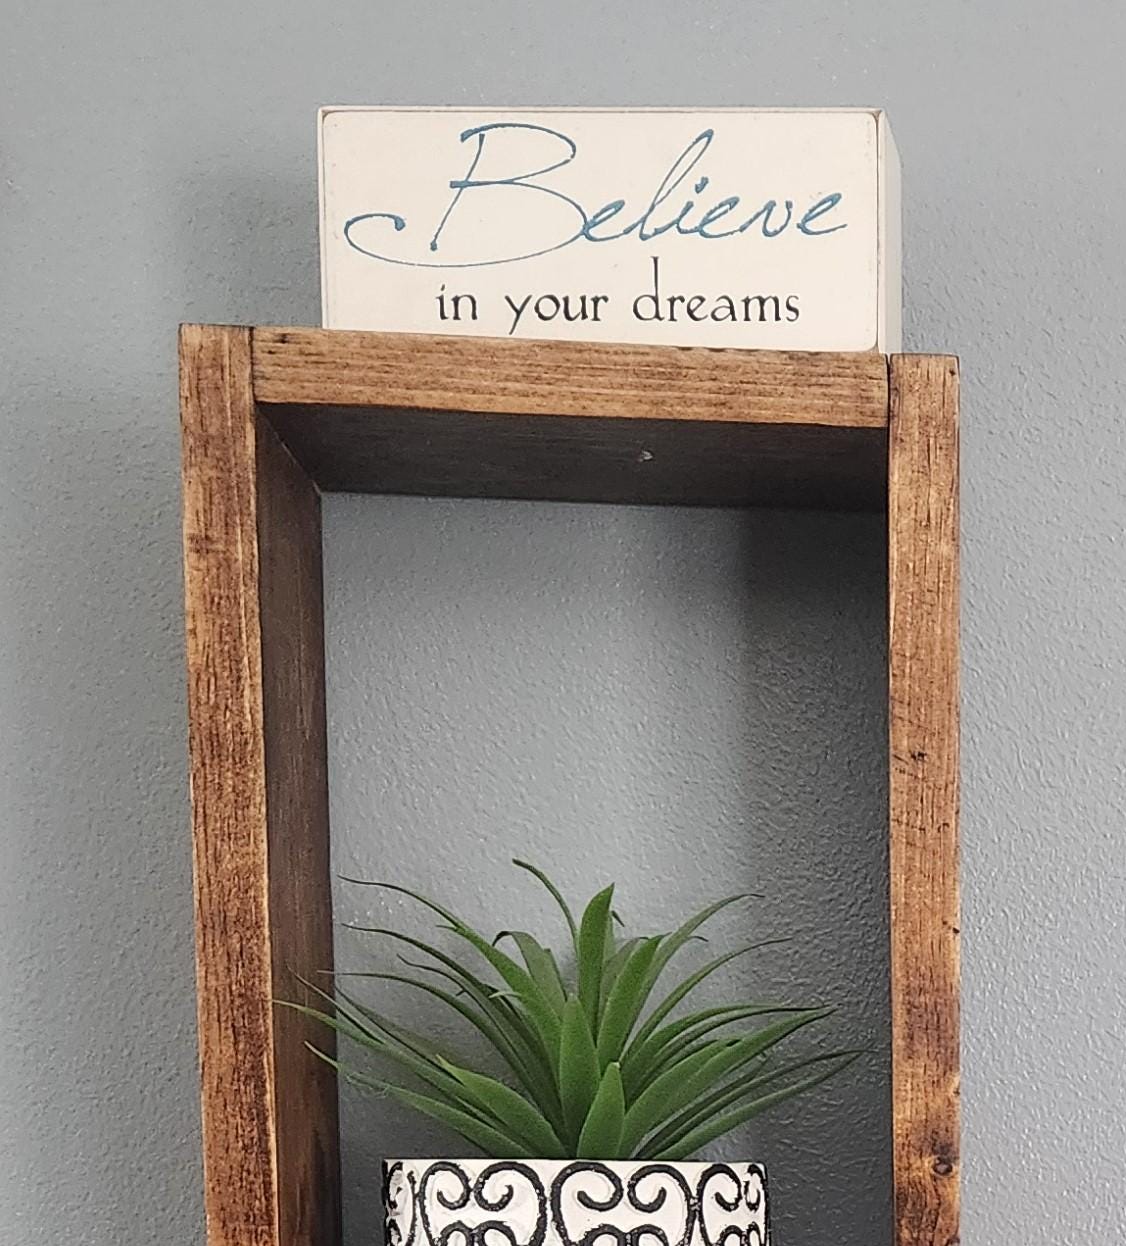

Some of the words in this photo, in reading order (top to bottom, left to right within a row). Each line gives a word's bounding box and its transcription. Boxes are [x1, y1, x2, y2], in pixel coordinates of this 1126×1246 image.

[344, 123, 848, 267] Believe
[436, 285, 478, 321] in
[504, 294, 609, 335] your
[633, 256, 801, 322] dreams
